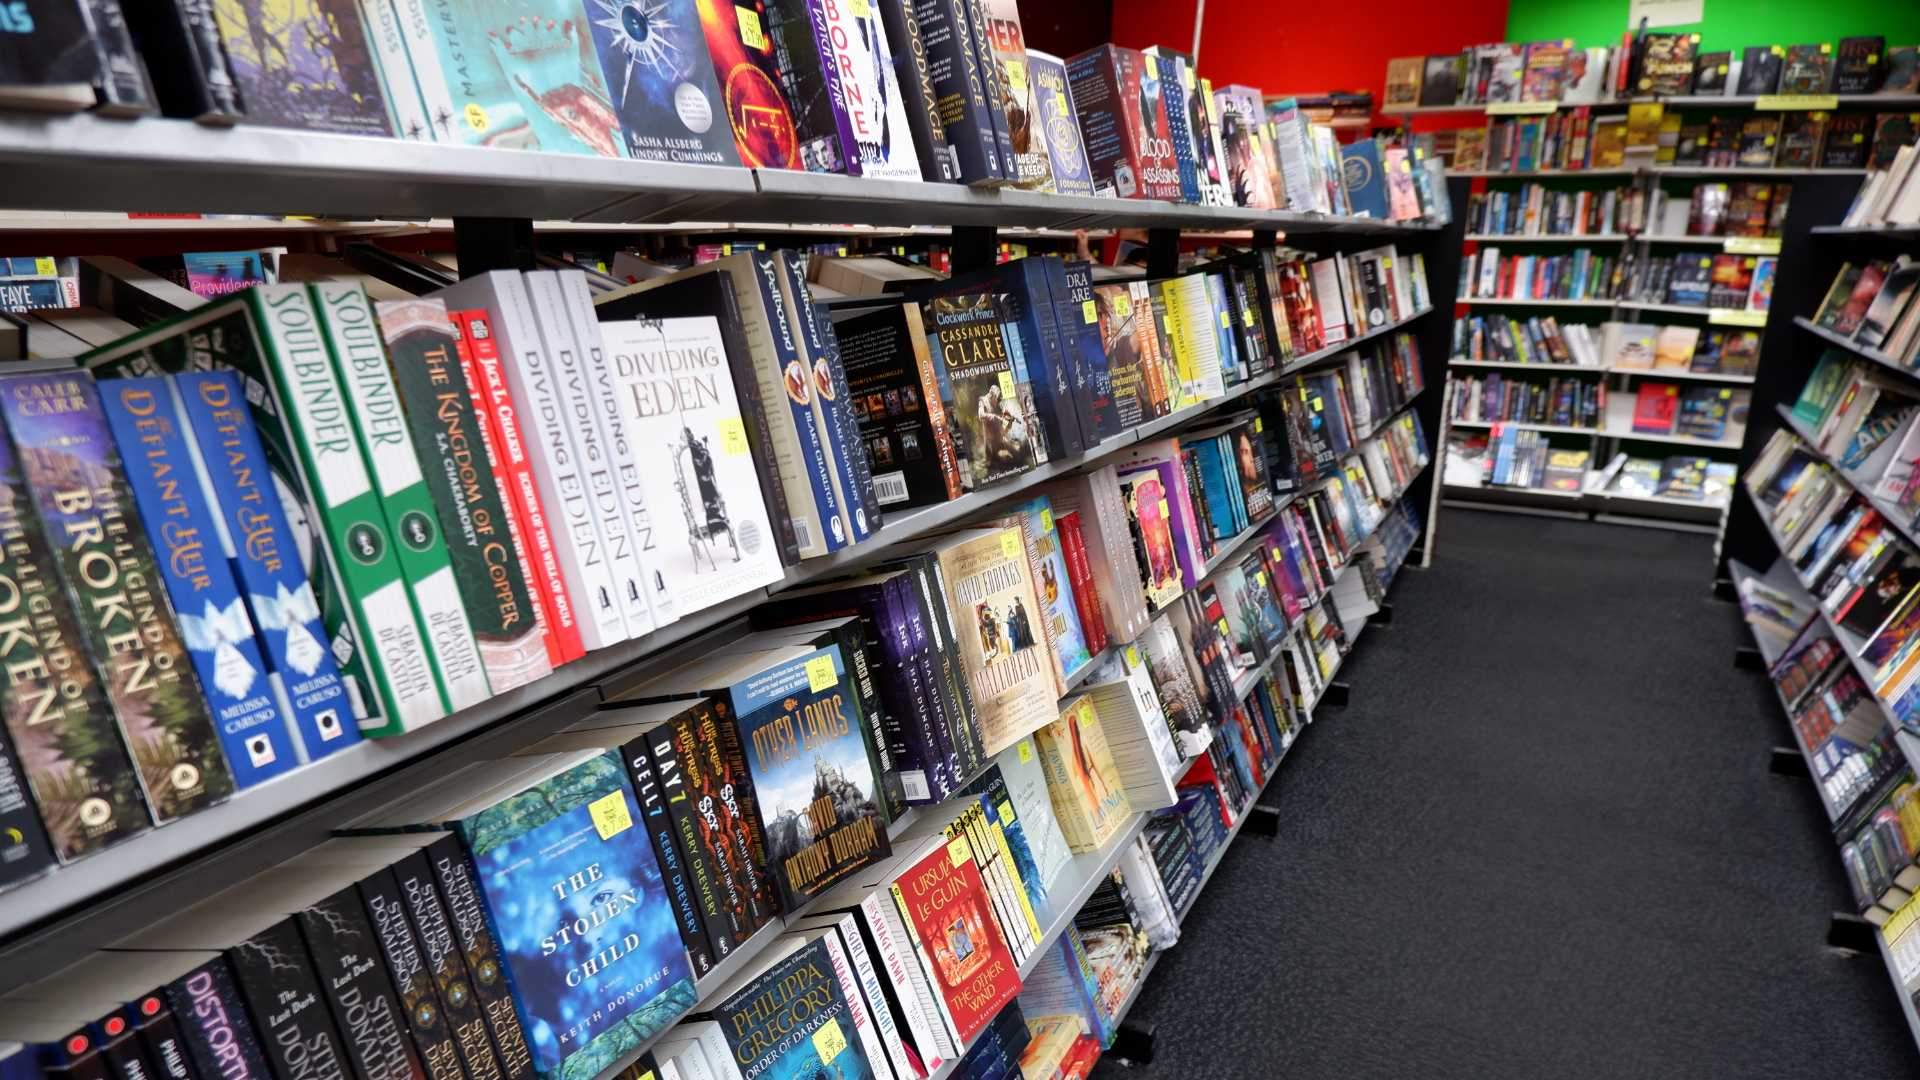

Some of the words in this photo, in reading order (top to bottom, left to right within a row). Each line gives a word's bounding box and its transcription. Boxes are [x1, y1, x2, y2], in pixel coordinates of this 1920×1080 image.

[824, 0, 869, 135] BORNE
[953, 0, 984, 107] ODMAGE
[986, 20, 1023, 50] HER
[629, 147, 669, 161] LINDSAY
[670, 150, 724, 163] CUMMINGS
[632, 133, 662, 149] SASHA
[664, 136, 703, 150] ALSBERG
[1140, 138, 1171, 158] BLOOD
[1143, 168, 1180, 184] ASSASSINS
[1, 286, 32, 305] FAYE
[936, 310, 974, 326] Clockwork
[975, 308, 995, 320] Prince
[425, 345, 449, 386] THE
[615, 346, 720, 377] DIVIDING
[941, 323, 999, 343] CASSANDRA
[944, 336, 1006, 367] CLARE
[266, 291, 350, 456] SOULBINDER
[326, 289, 404, 449] SOULBINDER
[630, 375, 720, 419] EDEN
[950, 361, 1008, 381] SHADOWHUNTERS
[480, 358, 497, 391] JACK
[498, 405, 524, 464] CHALKER
[201, 380, 262, 505] DEFIANT
[236, 506, 282, 574] HEIR
[436, 391, 485, 504] KINGDOM
[526, 351, 568, 467] DIVIDING
[558, 472, 600, 566] EDEN
[560, 349, 601, 461] DIVIDING
[591, 469, 630, 560] EDEN
[590, 347, 629, 456] DIVIDING
[619, 463, 656, 552] EDEN
[804, 411, 818, 447] BLAKE
[815, 449, 835, 508] CHARLTON
[831, 407, 844, 441] BLAKE
[841, 444, 861, 501] CHARLTON
[121, 388, 190, 518] DEFIANT
[161, 520, 212, 592] HEIR
[445, 458, 480, 547] CHAKRABORTY
[474, 508, 496, 537] OF
[54, 486, 158, 694] BROKEN
[114, 543, 165, 643] LEGEND
[483, 543, 520, 631] COPPER
[982, 559, 1022, 596] EDDINGS
[0, 573, 66, 727] OKEN
[16, 563, 73, 670] LEGEND
[446, 609, 477, 675] SEBASTIEN
[899, 624, 909, 650] INK
[912, 615, 923, 642] INK
[293, 674, 337, 697] MELISSA
[399, 624, 430, 693] SEBASTIEN
[221, 696, 271, 720] MELISSA
[224, 710, 275, 735] CARUSO
[296, 686, 341, 709] CARUSO
[794, 694, 849, 752] LANDS
[653, 740, 683, 789] DAY
[670, 790, 687, 804] 7
[552, 862, 603, 901] THE
[659, 830, 678, 871] KERRY
[672, 873, 698, 935] DREWERY
[680, 816, 698, 855] KERRY
[692, 858, 718, 917] DREWERY
[785, 836, 830, 892] ANTHONY
[829, 815, 880, 864] DURHAM
[912, 854, 953, 897] URSULA
[404, 876, 446, 975] DONALDSON
[422, 883, 454, 955] STEPHEN
[437, 857, 477, 951] DONALDSON
[453, 863, 484, 934] STEPHEN
[541, 887, 640, 957] STOLEN
[932, 872, 968, 914] GUIN
[340, 953, 358, 969] The
[352, 957, 375, 977] Dark
[370, 895, 414, 995] DONALDSON
[388, 901, 422, 975] STEPHEN
[565, 932, 641, 989] CHILD
[830, 949, 852, 993] SAVAGE
[848, 931, 865, 962] GIRL
[859, 960, 872, 977] AT
[871, 911, 893, 952] SAVAGE
[887, 951, 906, 986] DAWN
[278, 989, 297, 1005] The
[292, 993, 317, 1013] Dark
[559, 1012, 602, 1044] KEITH
[607, 965, 671, 1012] DONOHUE
[731, 963, 825, 1037] PHILIPPA
[865, 977, 895, 1036] MIDNIGHT
[952, 987, 974, 1012] THE
[972, 959, 1006, 993] OTHER
[968, 983, 996, 1012] WIND
[185, 971, 249, 1080] DISTORT
[338, 987, 389, 1080] DONALD
[367, 994, 414, 1080] STEPHE
[486, 1001, 522, 1079] DECIMATE
[501, 995, 531, 1068] SEVENTH
[736, 978, 834, 1066] GREGORY
[745, 1050, 780, 1080] ORDER
[779, 1037, 794, 1054] OF
[793, 1001, 844, 1043] DARKNESS
